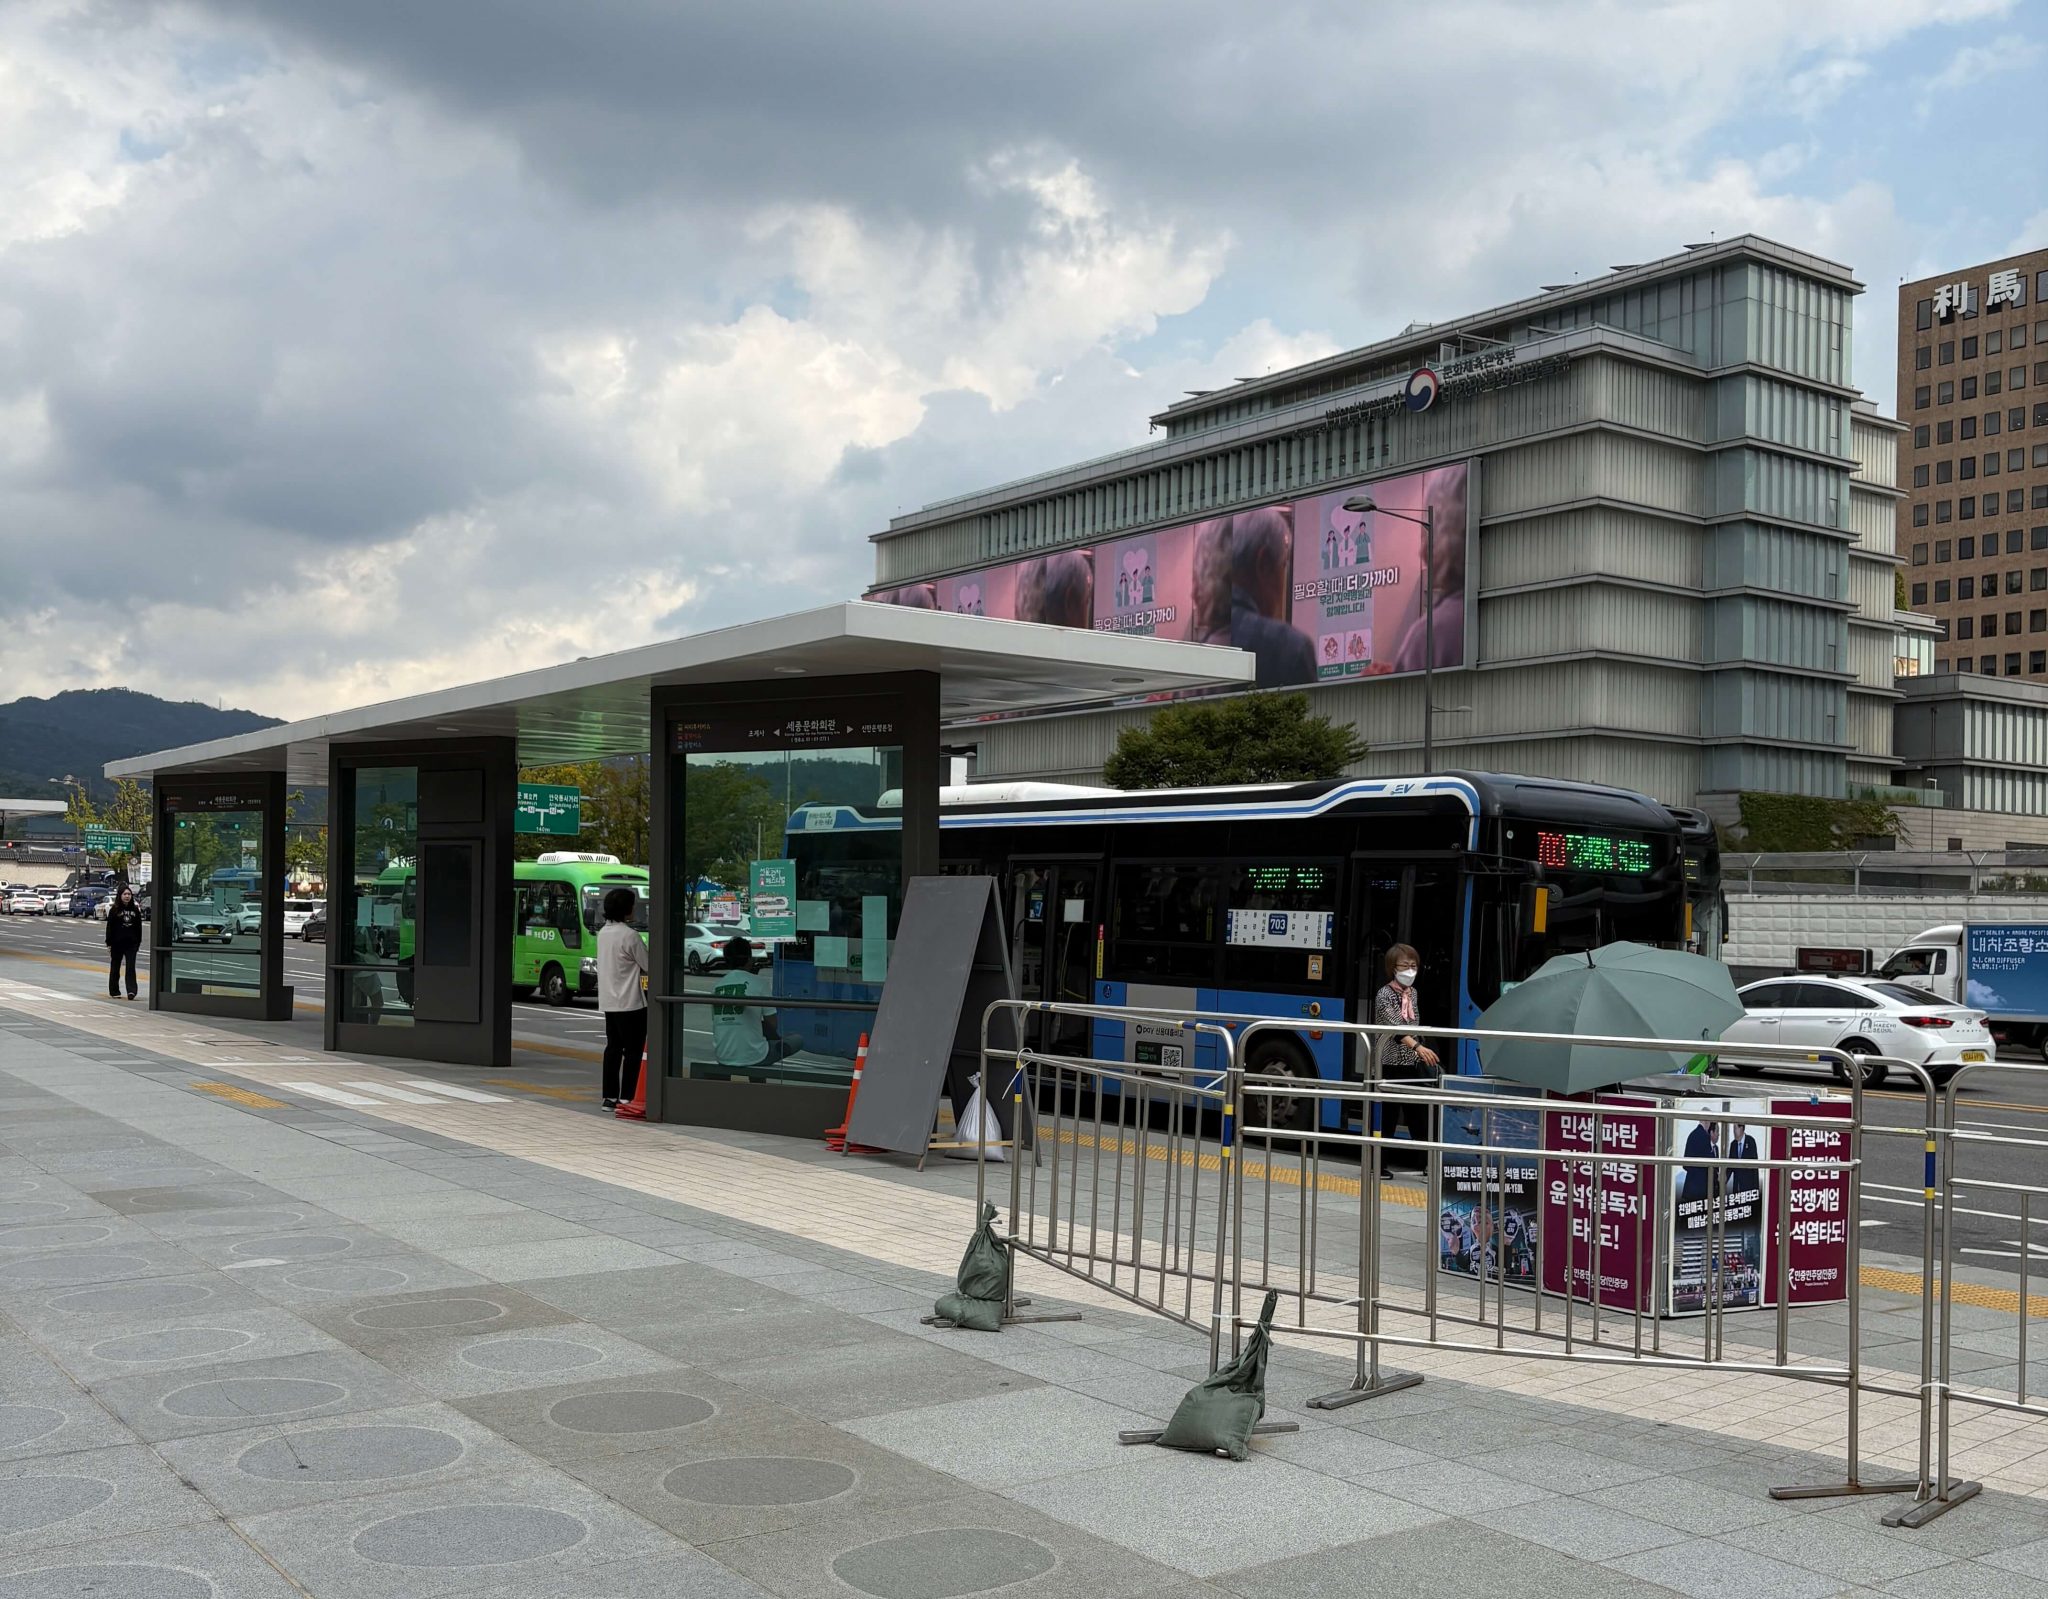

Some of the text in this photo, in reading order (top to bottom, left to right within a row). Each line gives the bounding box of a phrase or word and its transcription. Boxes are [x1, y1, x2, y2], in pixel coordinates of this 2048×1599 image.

[1933, 268, 2021, 318] 利馬
[1294, 567, 1399, 600] 필요할 때 더 가까이
[1095, 616, 1121, 632] 필요할
[1123, 614, 1133, 628] 때
[1135, 612, 1144, 626] 더
[1146, 606, 1175, 624] 가까이
[786, 719, 836, 733] 세종문화회관
[1391, 783, 1416, 795] EV
[1270, 918, 1286, 930] 703
[1972, 937, 2048, 954] 내차조향소
[1443, 1166, 1469, 1178] 민생파탄
[1520, 1167, 1538, 1180] 타도!
[1456, 1181, 1472, 1192] DOWN
[1471, 1182, 1482, 1192] WIT
[1728, 1188, 1760, 1206] 윤석열타도!
[1789, 1187, 1840, 1213] 전쟁계엄
